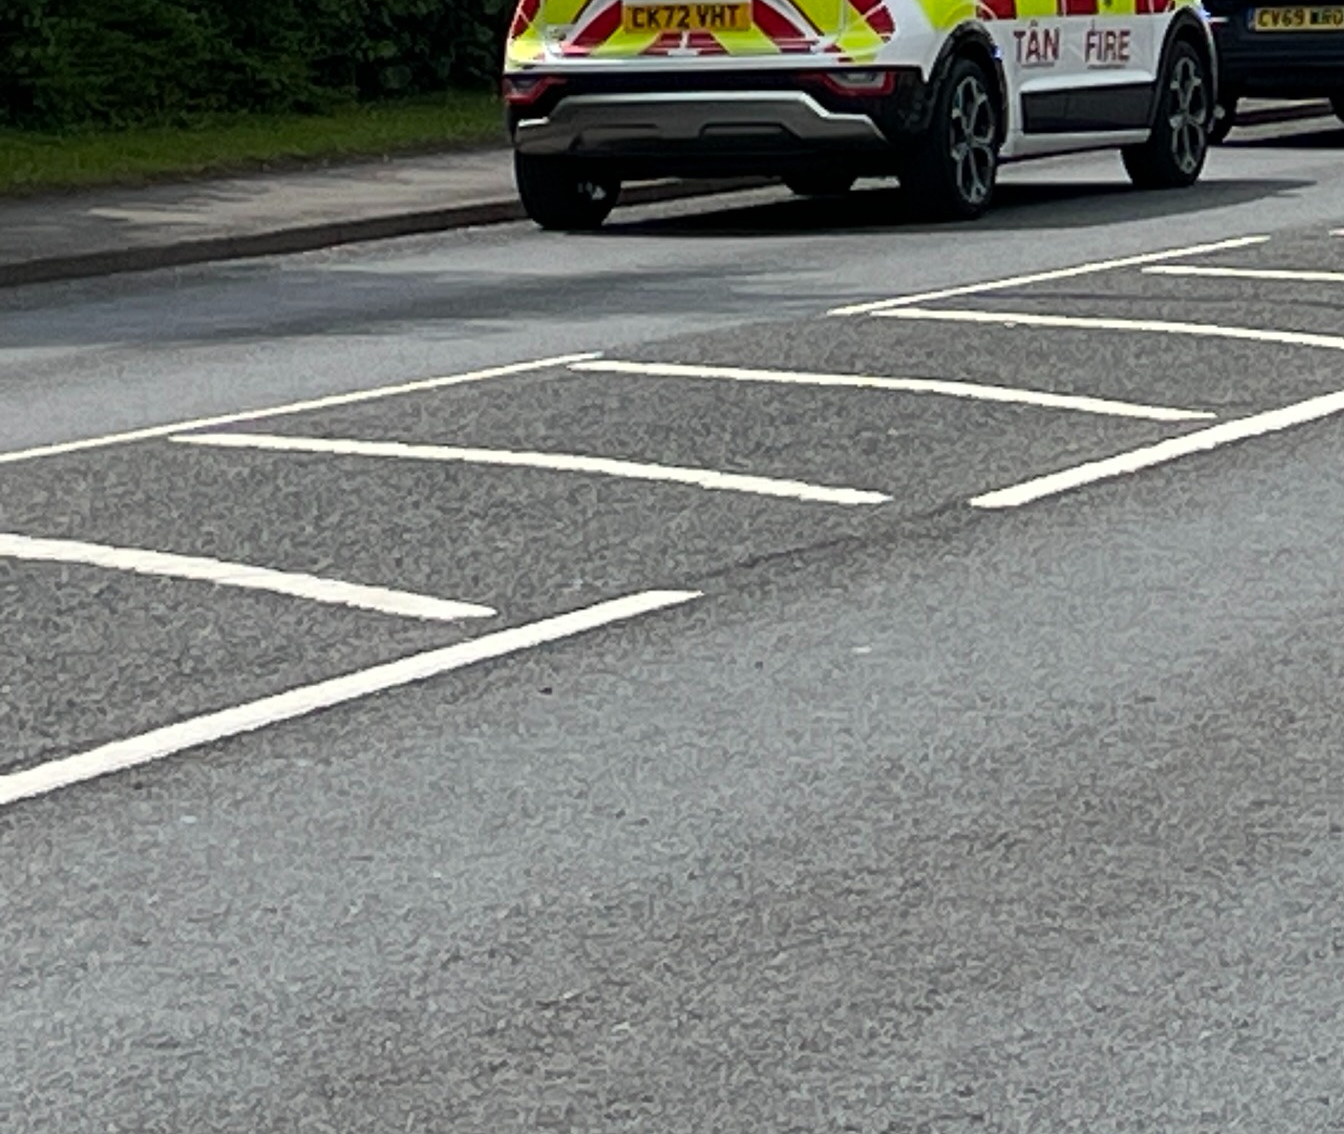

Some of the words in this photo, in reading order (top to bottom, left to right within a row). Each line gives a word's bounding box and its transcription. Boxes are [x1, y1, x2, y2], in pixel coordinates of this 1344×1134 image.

[632, 5, 690, 28] CK72
[1013, 19, 1060, 63] TÂN
[1085, 30, 1131, 62] FIRE
